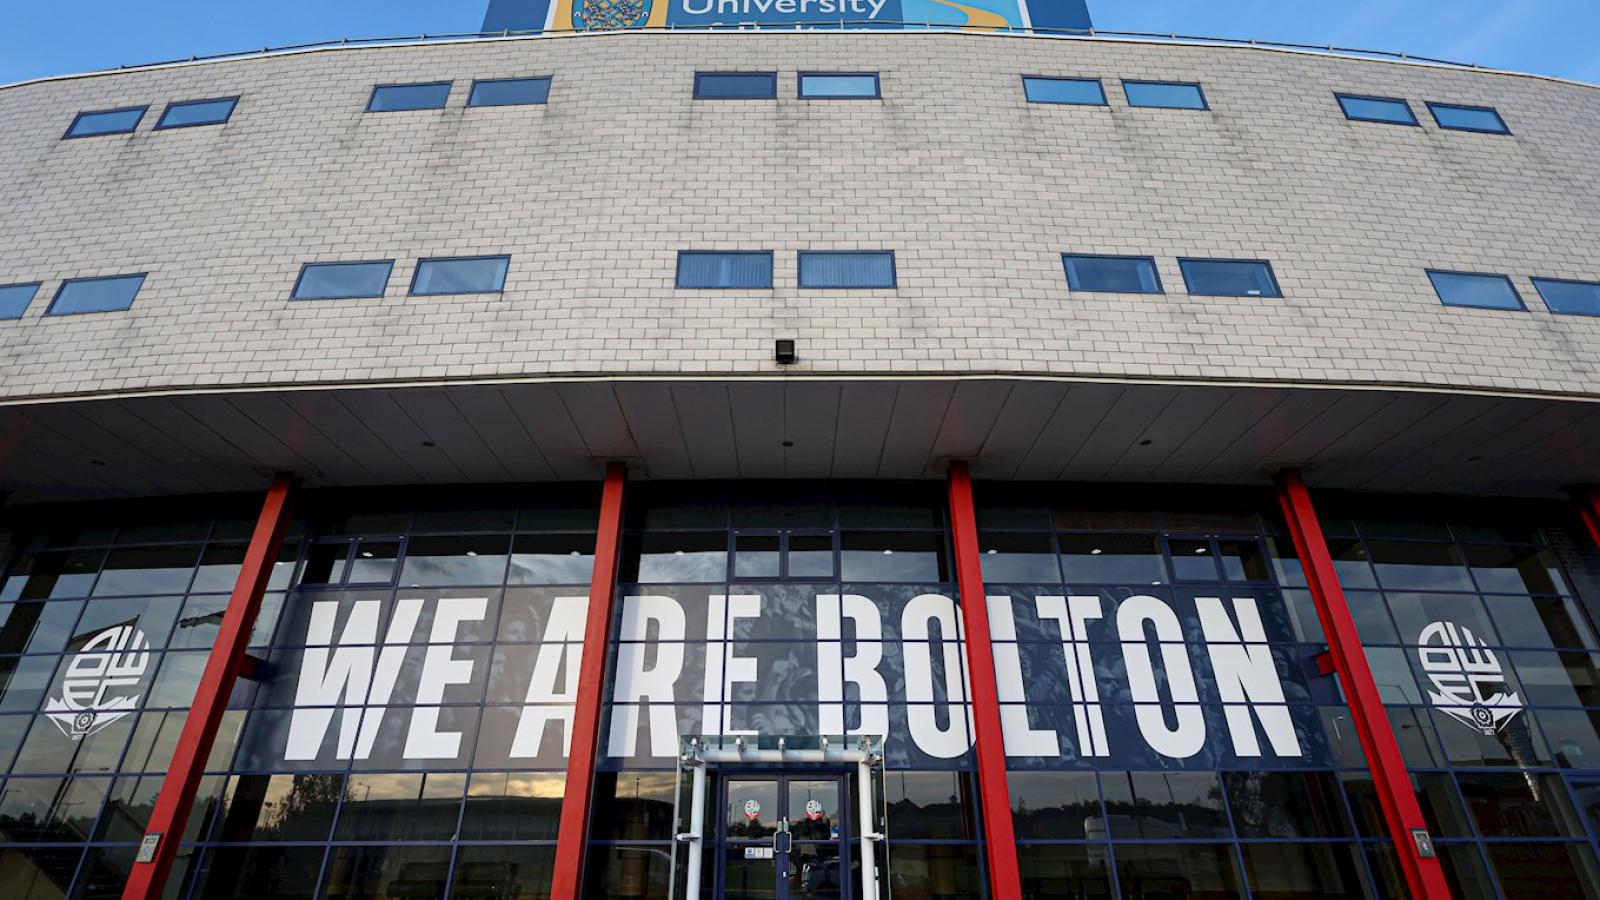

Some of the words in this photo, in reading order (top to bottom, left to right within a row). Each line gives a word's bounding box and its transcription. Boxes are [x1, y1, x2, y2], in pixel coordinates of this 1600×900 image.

[683, 0, 886, 19] University
[284, 598, 488, 760] WE
[509, 595, 761, 757] ARE
[816, 594, 1302, 758] BOLTON
